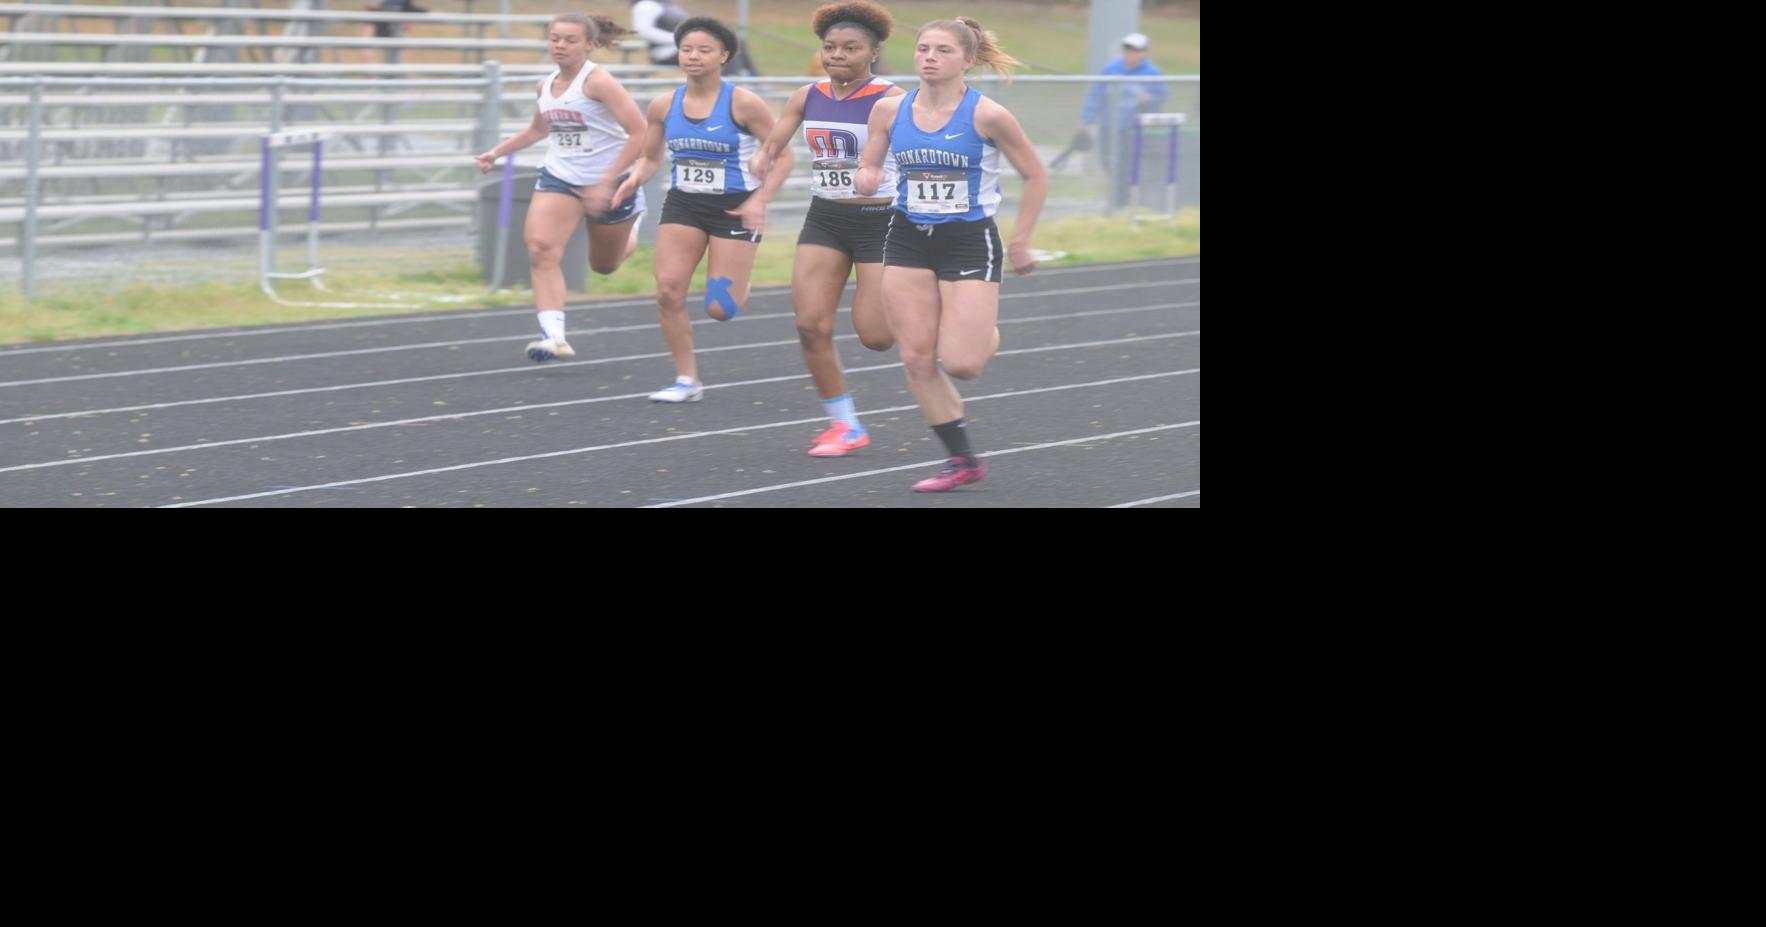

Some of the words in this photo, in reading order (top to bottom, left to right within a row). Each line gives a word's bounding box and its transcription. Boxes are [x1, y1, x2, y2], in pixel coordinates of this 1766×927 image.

[683, 168, 715, 184] 129
[820, 171, 852, 187] 186
[917, 182, 955, 200] 117
